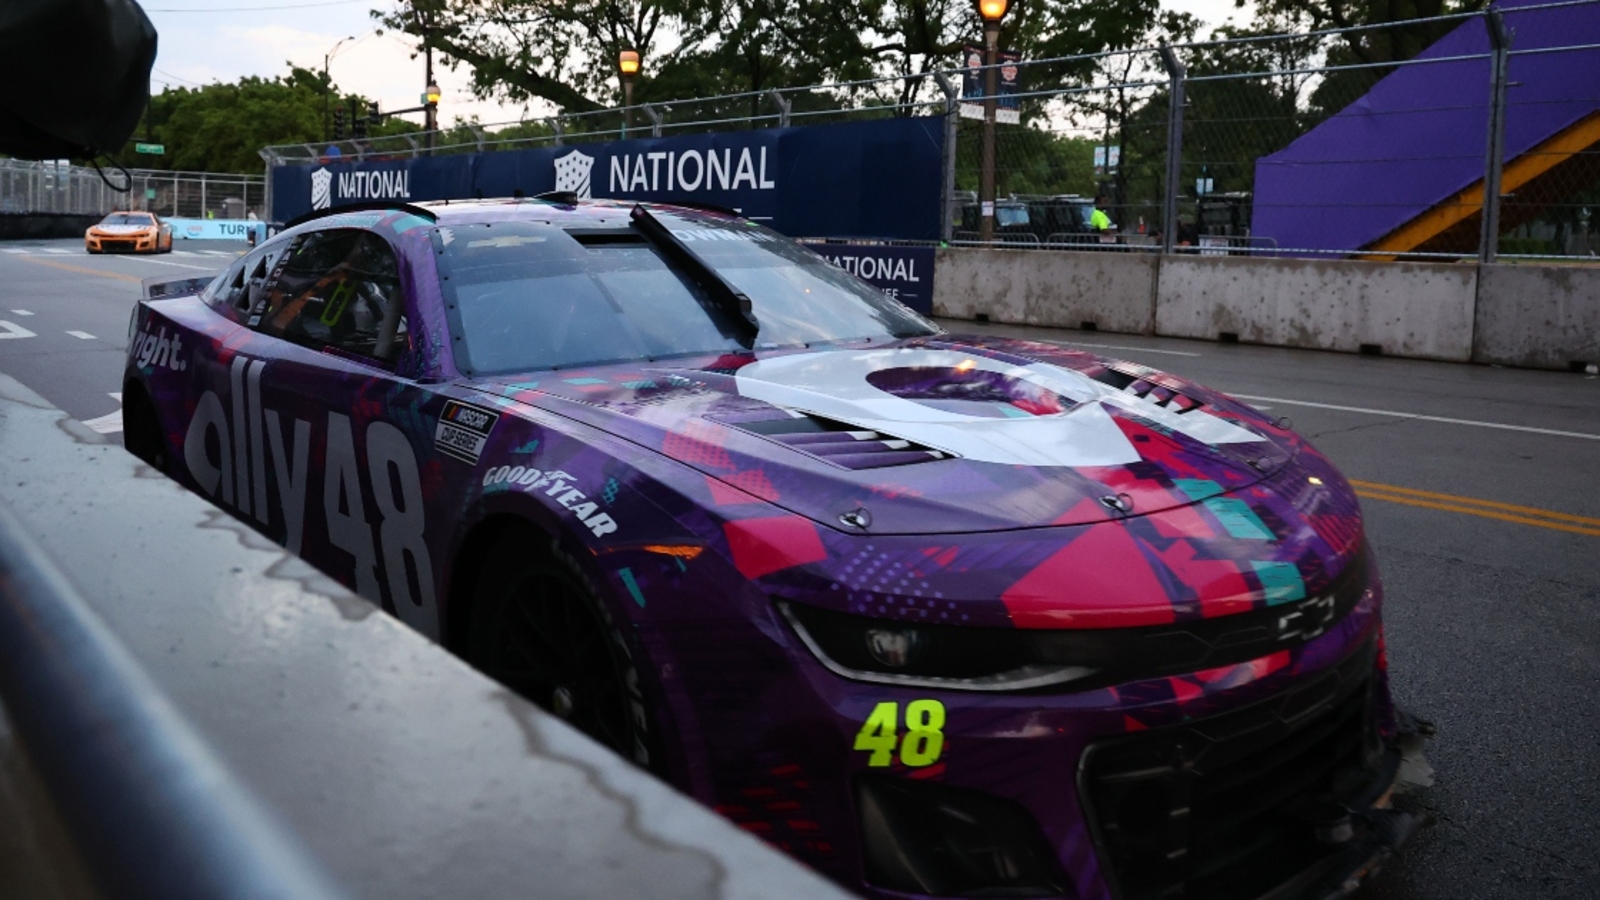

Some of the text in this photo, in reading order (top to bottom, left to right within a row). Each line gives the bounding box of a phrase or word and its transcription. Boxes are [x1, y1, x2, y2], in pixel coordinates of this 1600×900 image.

[610, 146, 775, 193] NATIONAL
[338, 169, 411, 199] NATIONAL
[219, 223, 248, 235] TUR
[670, 229, 778, 242] OWMAN
[457, 408, 488, 429] NASCAR
[441, 426, 479, 451] CUP SERIES
[184, 356, 441, 645] ally 48
[853, 699, 946, 767] 48
